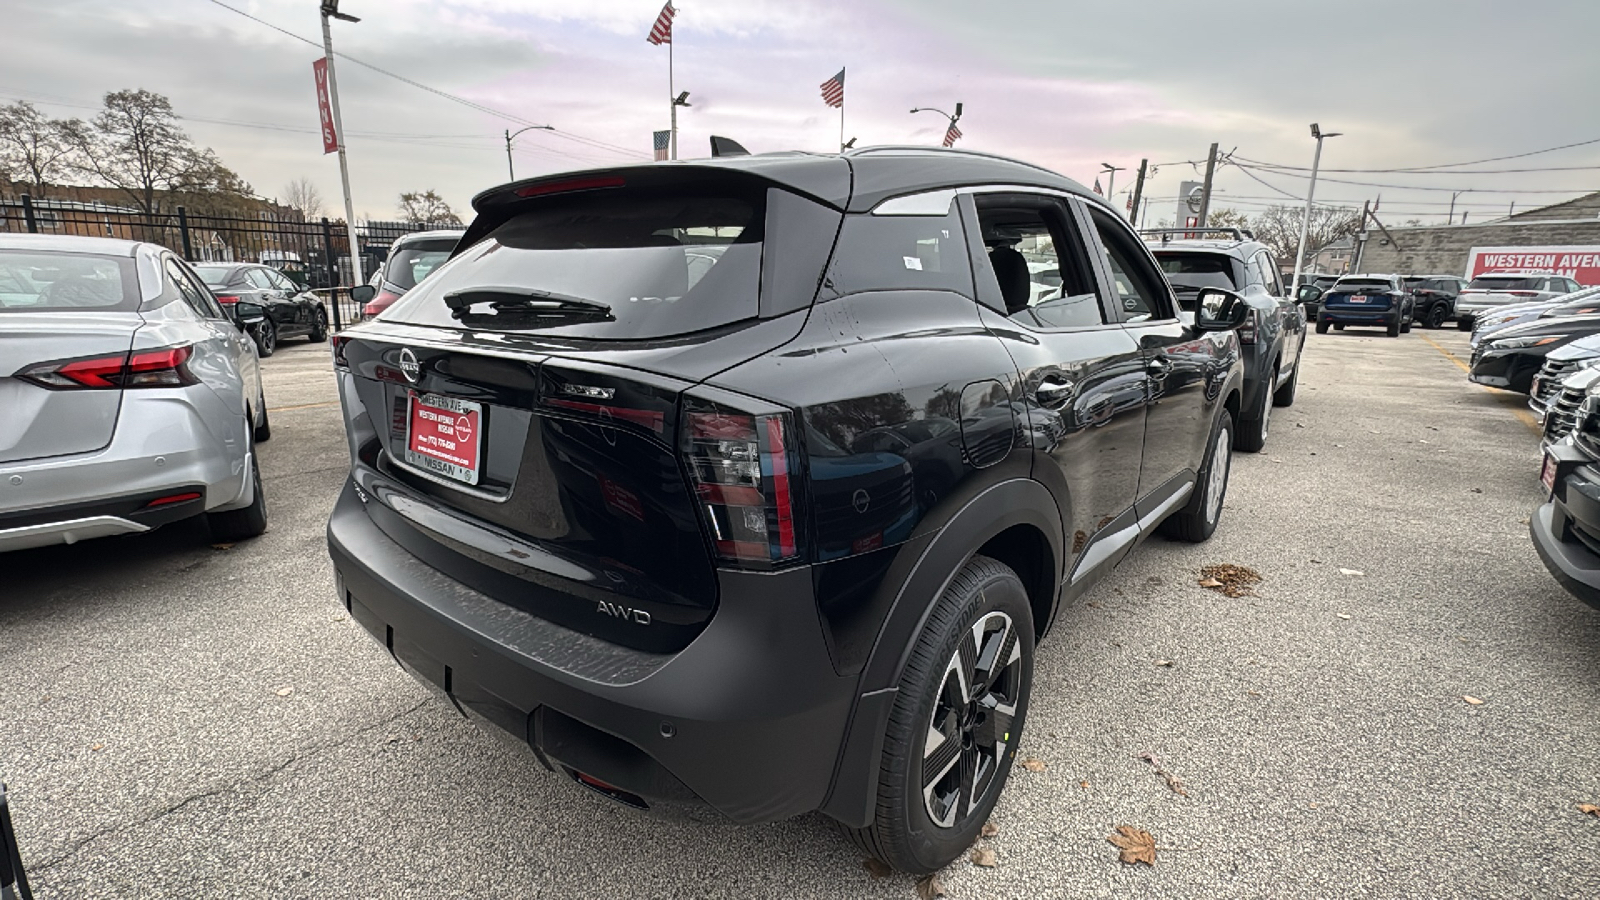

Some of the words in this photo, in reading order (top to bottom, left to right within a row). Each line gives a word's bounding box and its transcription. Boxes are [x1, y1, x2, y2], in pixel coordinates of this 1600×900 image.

[317, 68, 332, 144] VANS
[1484, 255, 1556, 268] WESTERN
[419, 410, 437, 421] WESTERN
[424, 456, 456, 476] NISSAN
[597, 600, 651, 626] AWD
